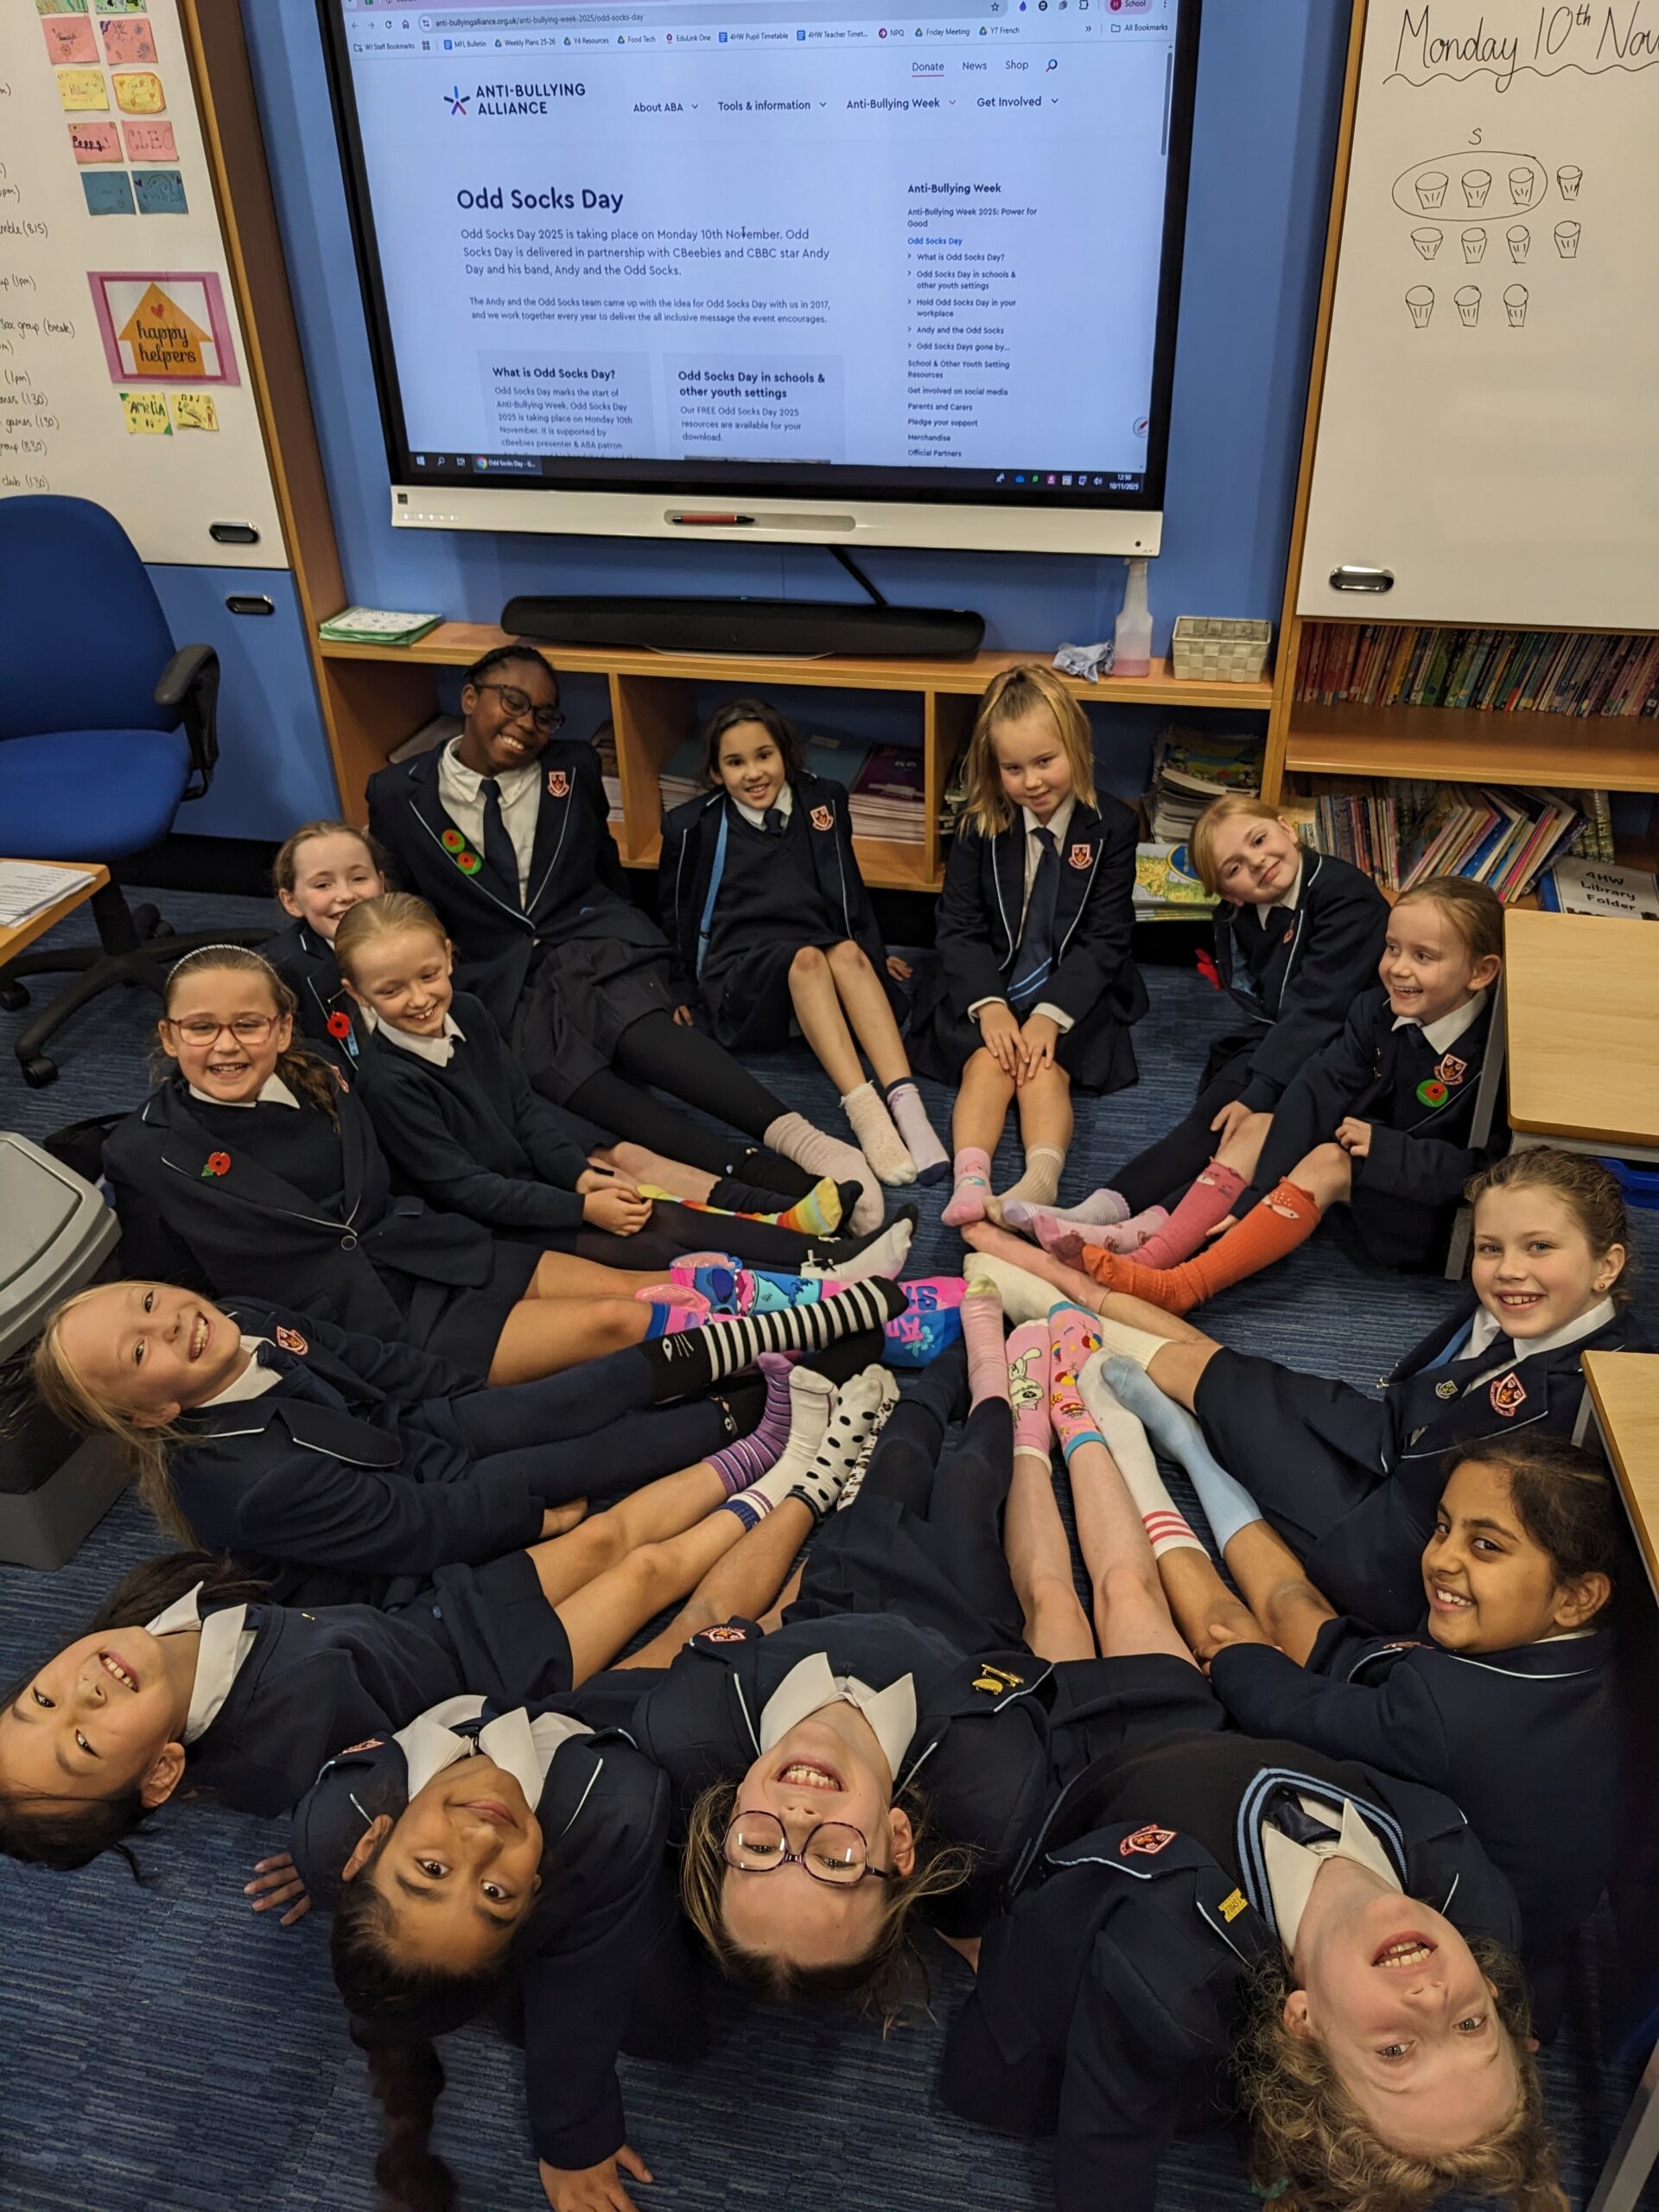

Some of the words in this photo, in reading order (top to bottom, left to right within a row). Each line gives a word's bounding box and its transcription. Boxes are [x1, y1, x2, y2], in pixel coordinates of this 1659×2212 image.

[1395, 5, 1518, 92] Monday
[1534, 4, 1591, 60] 10th
[912, 62, 945, 72] Donate
[962, 62, 988, 71] News
[1006, 59, 1029, 71] Shop
[476, 83, 586, 98] ANTI-BULLYING
[478, 102, 548, 115] ALLIANCE
[633, 102, 662, 112] About
[664, 103, 684, 112] ABA
[718, 101, 743, 111] Tools
[746, 101, 753, 111] &
[755, 100, 811, 111] information
[847, 98, 909, 111] Anti-Bullying
[912, 98, 940, 108] Week
[977, 98, 996, 107] Get
[999, 96, 1042, 107] Involved
[908, 183, 971, 196] Anti-Bullying
[973, 183, 1002, 193] Week
[457, 187, 504, 209] Odd
[511, 187, 575, 209] Socks
[582, 189, 624, 214] Day
[908, 207, 954, 218] Anti-Bullying
[1027, 207, 1038, 216] for
[461, 228, 483, 239] Odd
[485, 229, 515, 239] Socks
[517, 229, 536, 242] Day
[539, 229, 564, 240] 2025
[566, 229, 574, 240] is
[576, 228, 608, 242] taking
[611, 228, 639, 242] place
[657, 229, 698, 242] Monday
[701, 229, 723, 240] 10th
[786, 229, 809, 240] Odd
[908, 237, 924, 245] Odd
[949, 238, 963, 247] Day
[464, 246, 492, 257] Socks
[494, 247, 513, 259] Day
[515, 246, 524, 258] is
[526, 246, 573, 258] delivered
[575, 247, 585, 258] in
[587, 247, 645, 260] partnership
[647, 246, 671, 258] with
[673, 247, 722, 258] CBeebies
[725, 247, 744, 258] and
[747, 248, 777, 258] CBBC
[780, 249, 800, 259] star
[802, 247, 830, 261] Andy
[987, 254, 1005, 263] Day?
[466, 264, 484, 277] Day
[487, 263, 506, 275] and
[507, 264, 522, 275] his
[524, 264, 553, 277] band,
[554, 263, 580, 277] Andy
[583, 264, 602, 275] and
[604, 264, 621, 275] the
[624, 264, 647, 275] Odd
[649, 264, 682, 276] Socks.
[137, 320, 188, 347] happy
[917, 326, 936, 336] Andy
[937, 326, 951, 334] and
[139, 343, 196, 370] helpers
[492, 367, 521, 378] What
[523, 367, 531, 378] is
[534, 368, 556, 378] Odd
[559, 368, 589, 379] Socks
[591, 369, 616, 382] Day?
[678, 370, 701, 381] Odd
[704, 371, 735, 382] Socks
[738, 372, 758, 385] Day
[761, 371, 771, 383] in
[774, 372, 815, 383] schools
[818, 374, 825, 383] &
[680, 386, 708, 397] other
[711, 387, 742, 400] youth
[745, 387, 787, 401] settings
[1585, 871, 1624, 885] 4HW
[1580, 880, 1636, 901] Library
[1586, 894, 1636, 911] Folder
